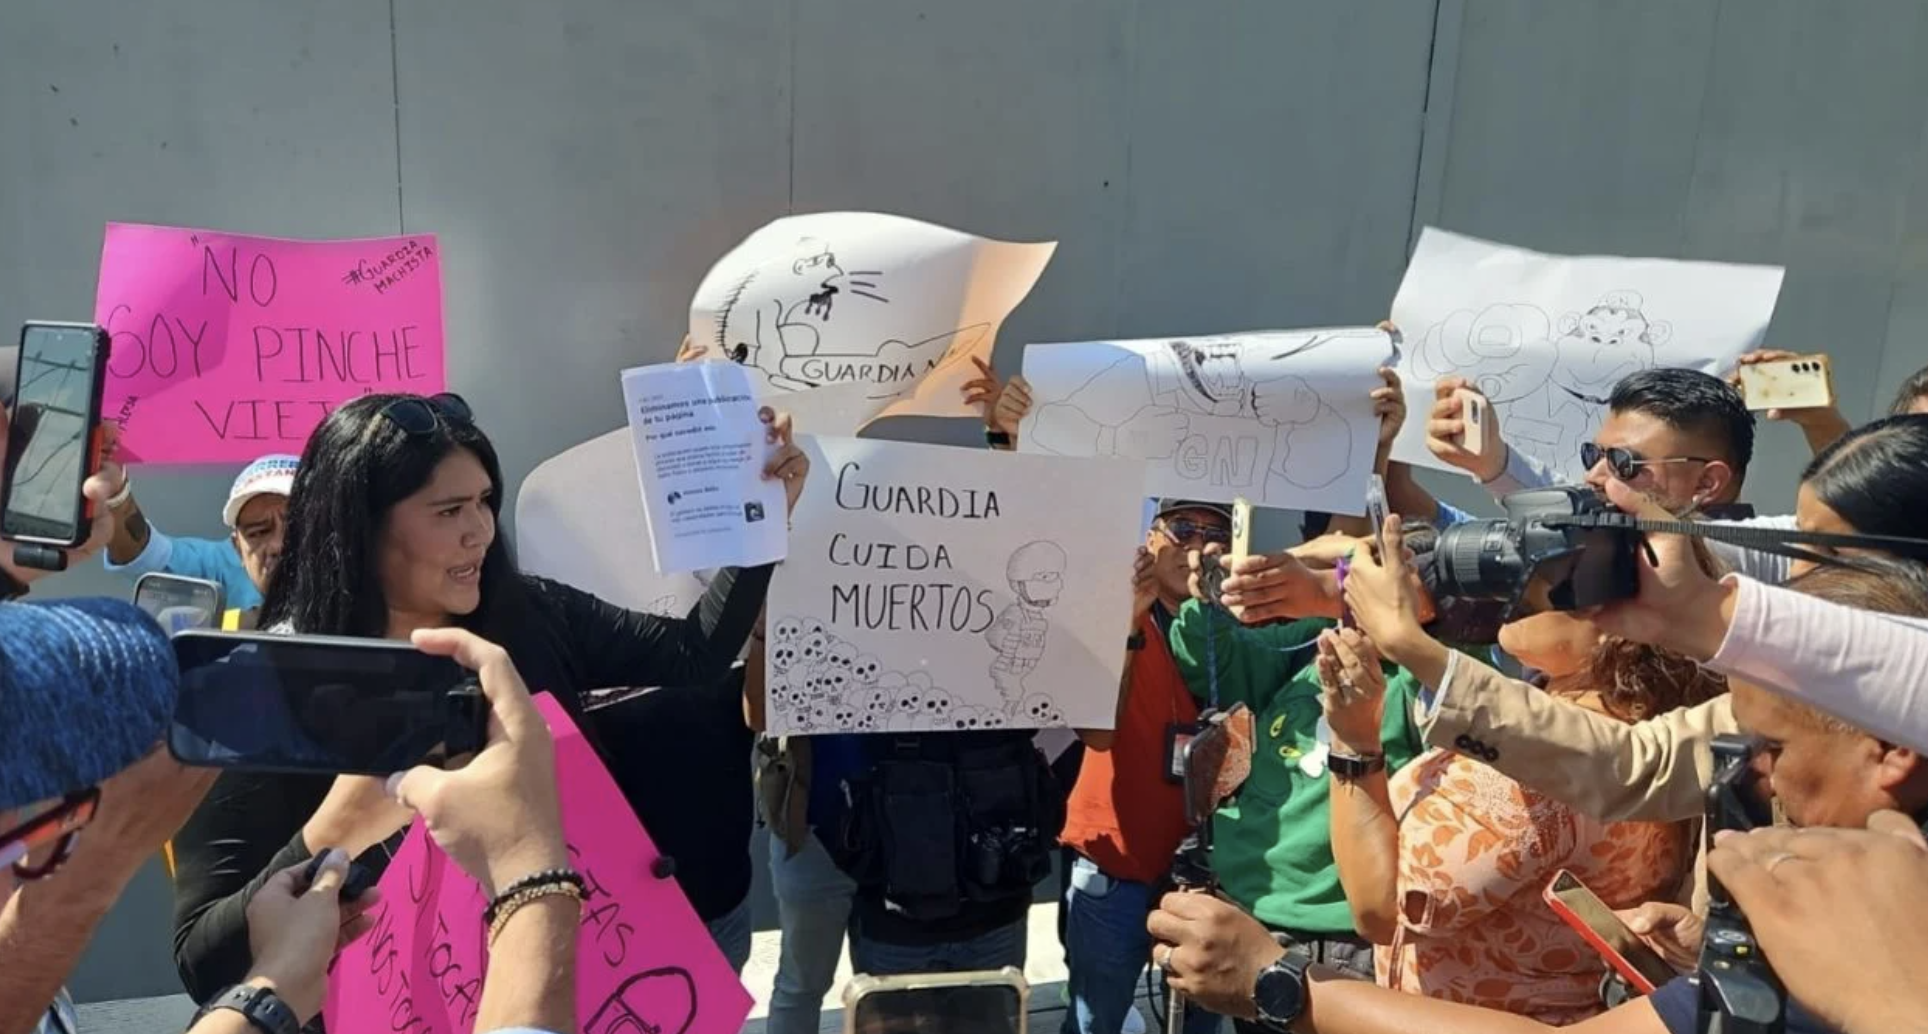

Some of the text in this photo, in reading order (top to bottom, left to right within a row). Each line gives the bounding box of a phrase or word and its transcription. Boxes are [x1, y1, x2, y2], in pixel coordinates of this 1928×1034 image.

[373, 245, 434, 295] MACHISTA
[106, 304, 427, 384] SOY PINCHE
[801, 358, 916, 384] GUARDIA
[1174, 433, 1260, 488] GN
[836, 461, 1001, 519] GUARDIA
[829, 532, 953, 571] CUIDA
[831, 583, 996, 634] MUERTOS
[424, 911, 480, 1026] TOCA
